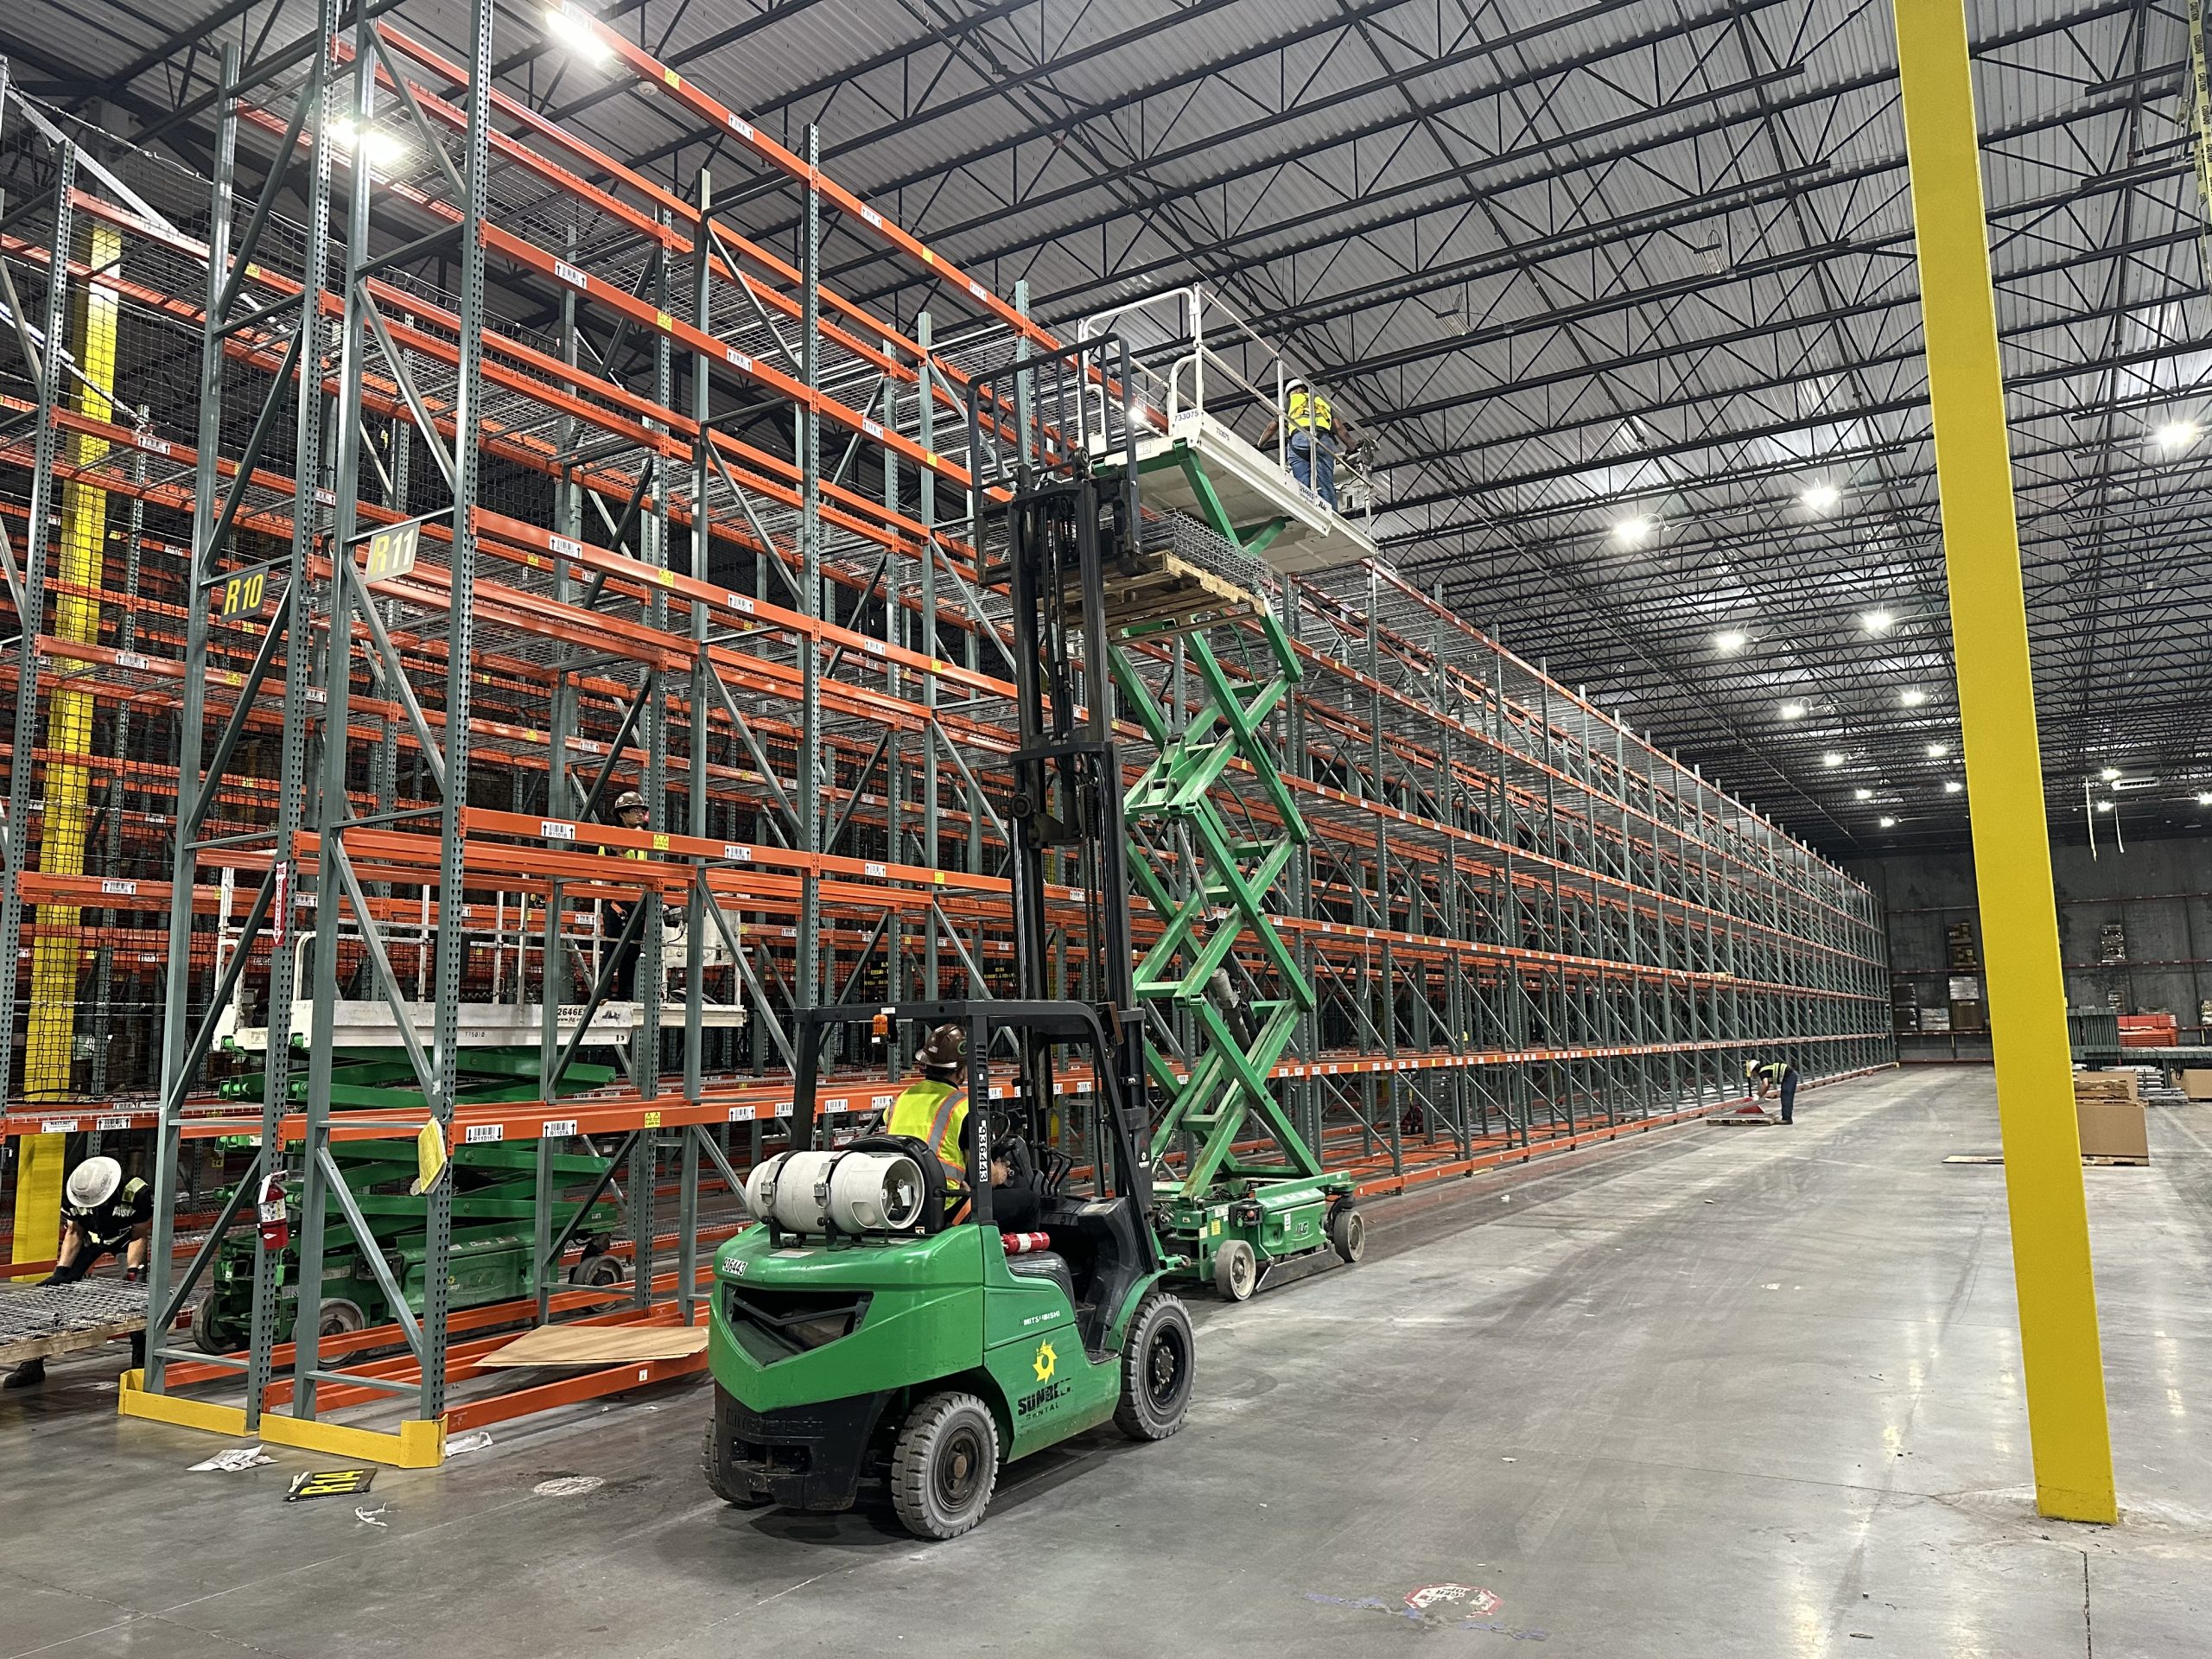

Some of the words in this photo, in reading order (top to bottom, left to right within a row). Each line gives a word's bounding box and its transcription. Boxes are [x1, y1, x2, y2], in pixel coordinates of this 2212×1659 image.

[1175, 410, 1199, 422] 733075
[370, 528, 415, 575] R11
[223, 573, 264, 616] R10
[473, 1134, 498, 1142] R1101FL
[978, 1126, 988, 1181] 936443
[298, 1470, 364, 1495] R14
